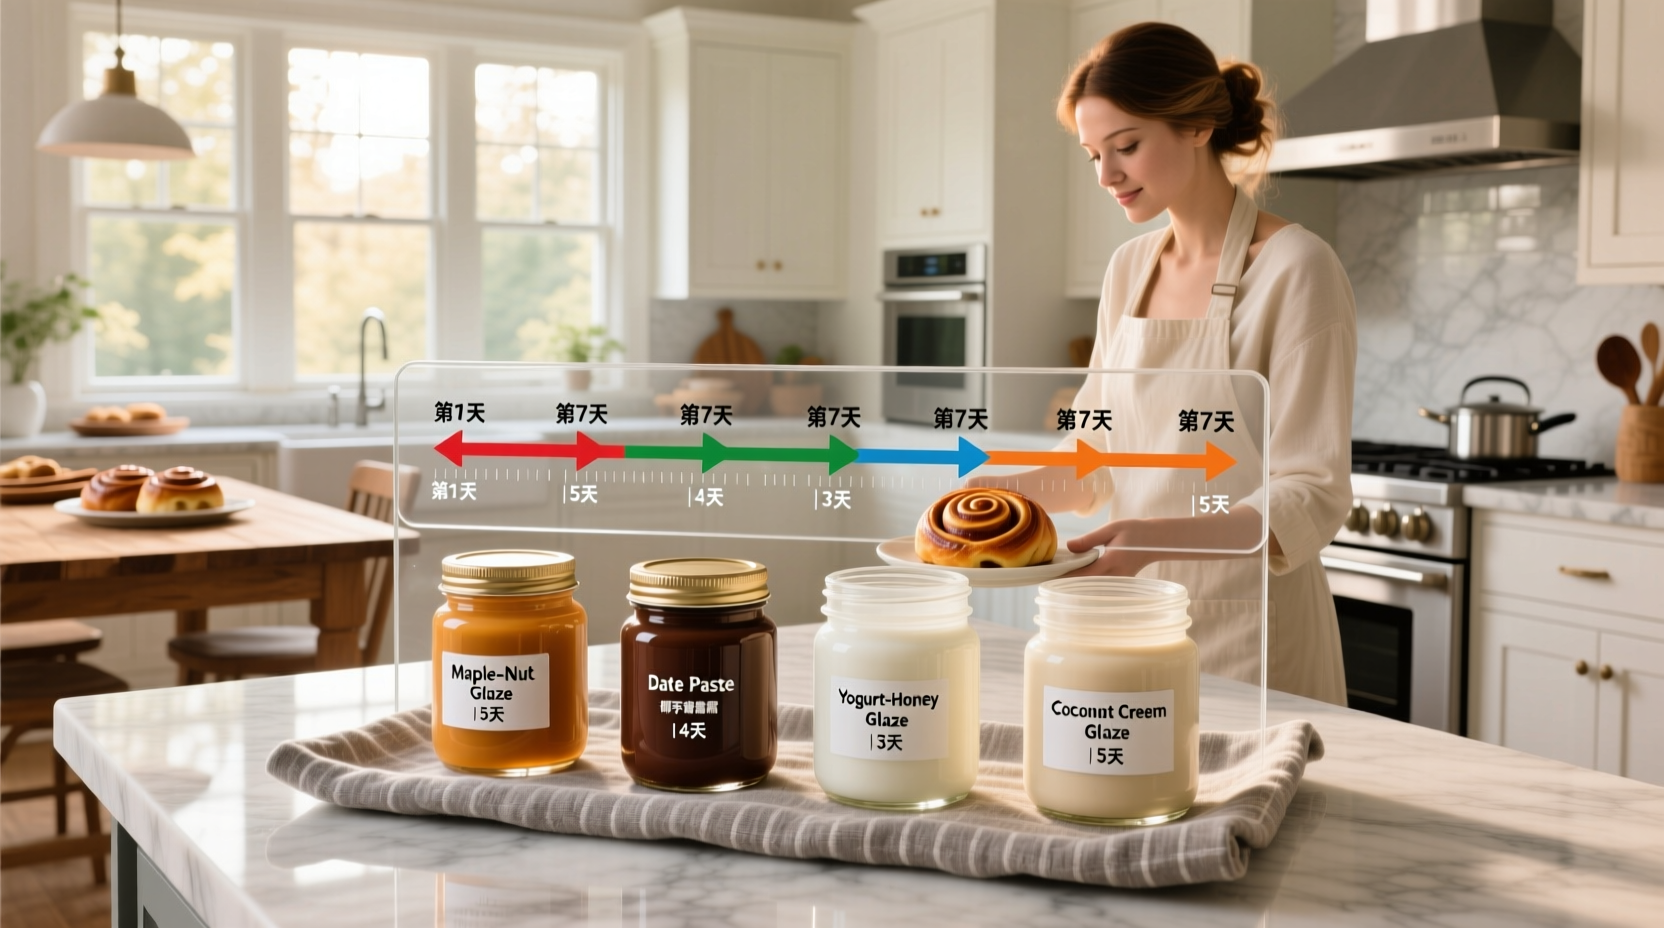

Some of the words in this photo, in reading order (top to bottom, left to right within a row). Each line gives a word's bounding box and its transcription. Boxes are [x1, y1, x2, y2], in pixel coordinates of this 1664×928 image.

[435, 400, 486, 424] 第1天
[556, 402, 608, 425] 第7天
[681, 403, 733, 426] 第7天
[808, 405, 861, 428] 第7天
[934, 407, 988, 431] 第7天
[1057, 408, 1112, 431] 第7天
[1178, 409, 1235, 433] 第7天
[431, 481, 477, 502] 第1天
[451, 664, 536, 685] Maple-Nut
[648, 673, 684, 692] Date
[689, 676, 735, 693] Paste
[470, 686, 514, 701] Glaze
[838, 688, 939, 710] Yogurt-Honey
[865, 711, 909, 727] Glaze
[1084, 723, 1130, 740] Glaze
